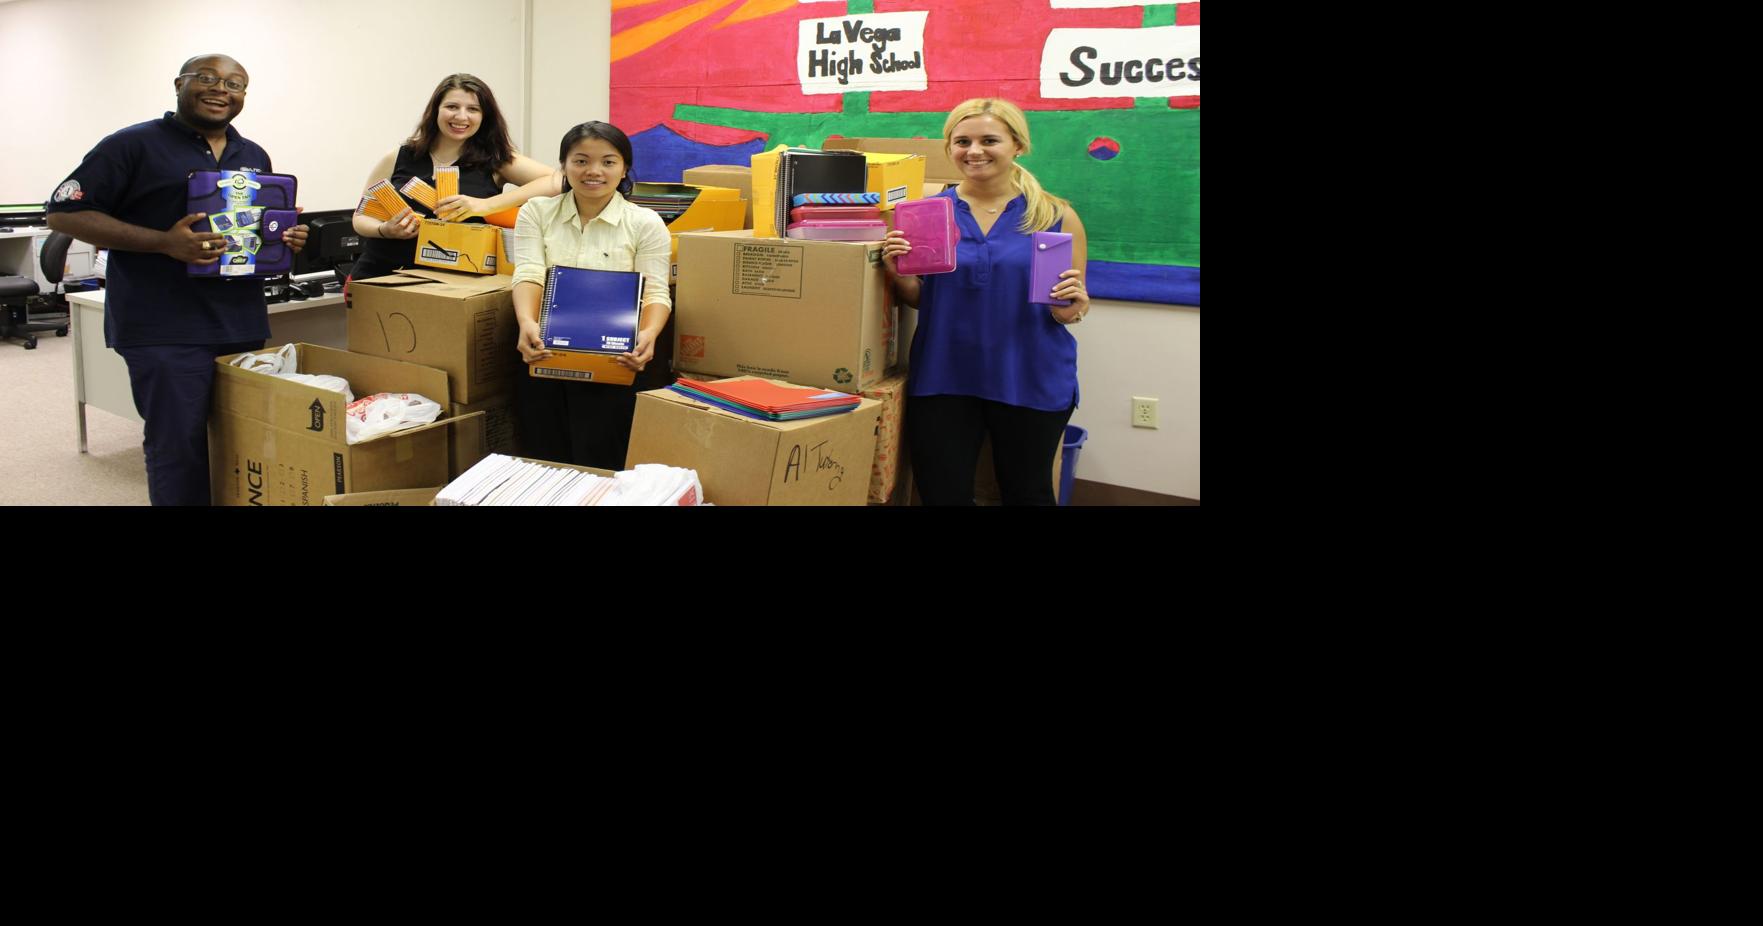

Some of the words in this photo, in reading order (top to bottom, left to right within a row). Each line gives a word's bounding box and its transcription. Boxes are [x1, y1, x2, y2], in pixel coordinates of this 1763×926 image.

[816, 22, 841, 44] La
[842, 20, 901, 51] Vega
[808, 49, 863, 85] High
[869, 50, 921, 76] School
[743, 245, 775, 253] FRAGILE
[301, 469, 310, 506] SPANISH
